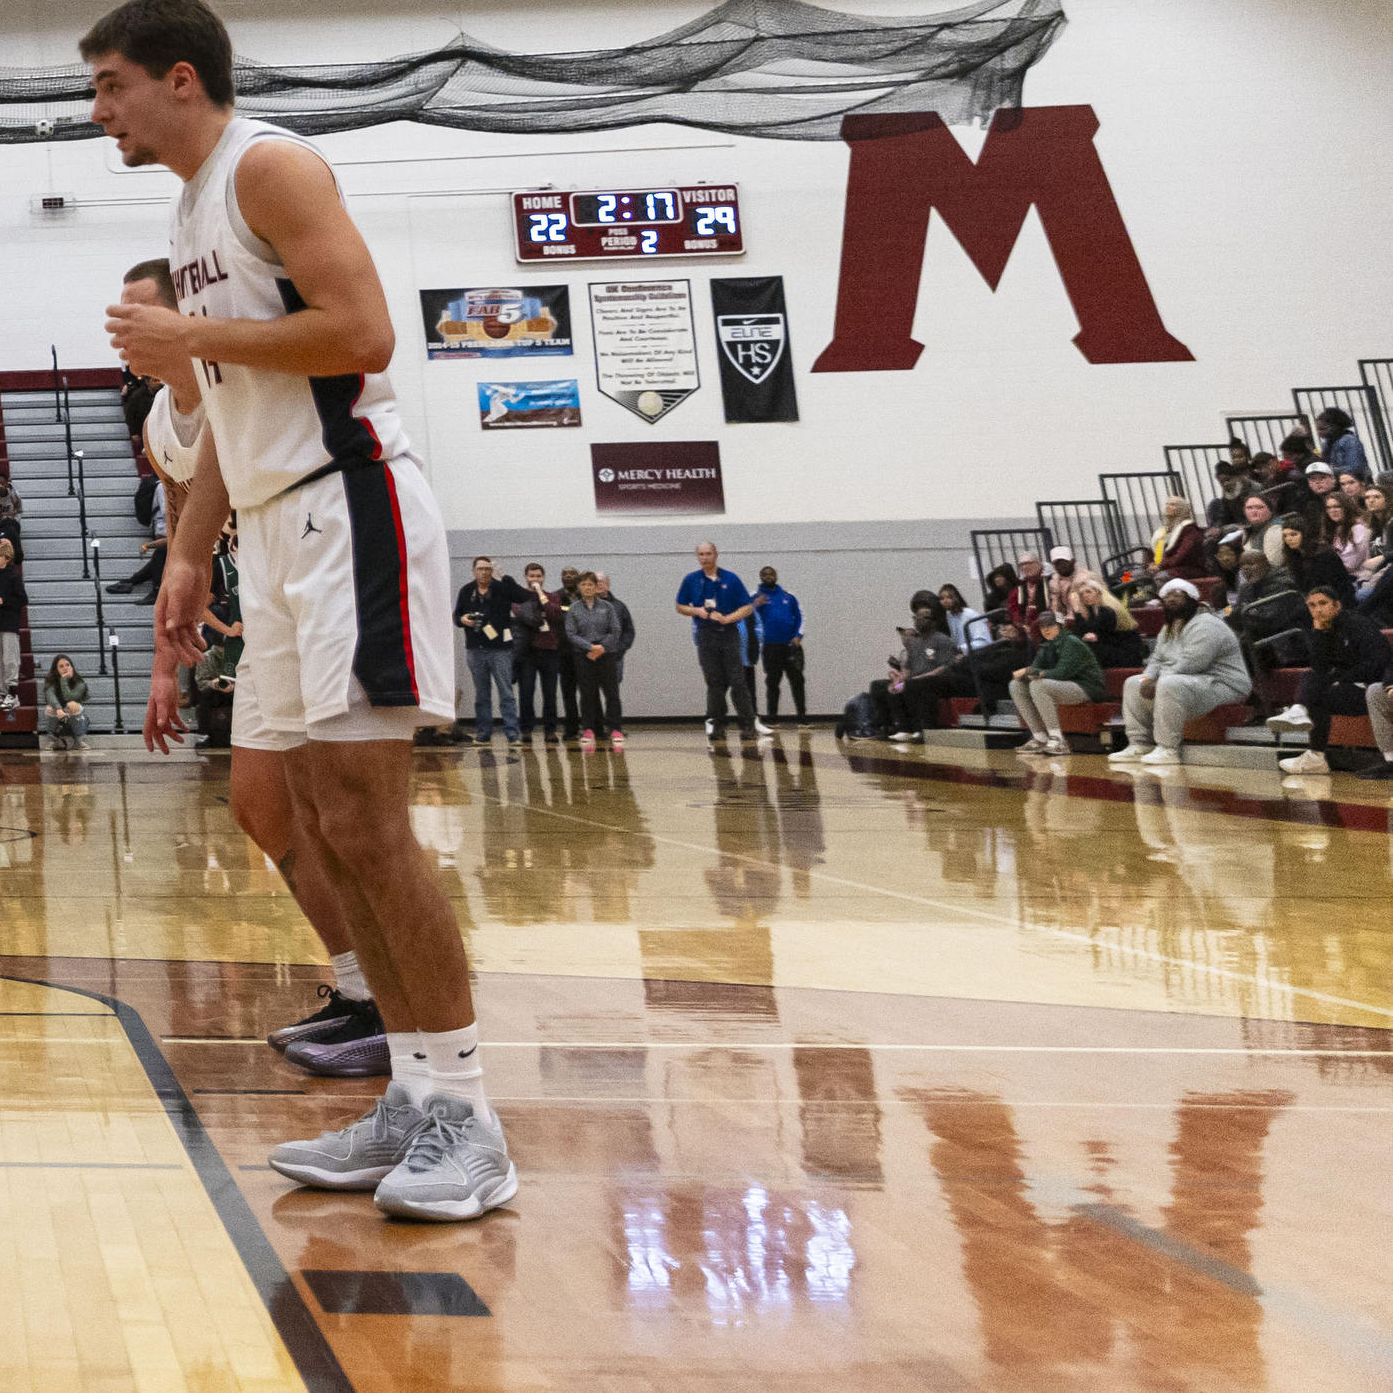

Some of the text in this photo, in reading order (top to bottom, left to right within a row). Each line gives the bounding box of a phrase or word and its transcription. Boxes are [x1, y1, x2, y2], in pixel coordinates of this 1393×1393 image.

[522, 196, 561, 210] HOME
[682, 189, 735, 203] VISITOR
[597, 191, 675, 222] 2:17
[529, 213, 567, 242] 22
[695, 207, 736, 235] 29
[601, 236, 637, 246] PERIOD
[641, 230, 658, 254] 2
[684, 239, 718, 250] BONUS
[811, 104, 1197, 373] M
[543, 245, 577, 255] BONUS
[467, 303, 523, 324] FAB 5
[731, 327, 773, 338] ELITE
[543, 338, 570, 346] TEAM
[737, 344, 771, 364] HS
[618, 468, 716, 480] MERCY HEALTH
